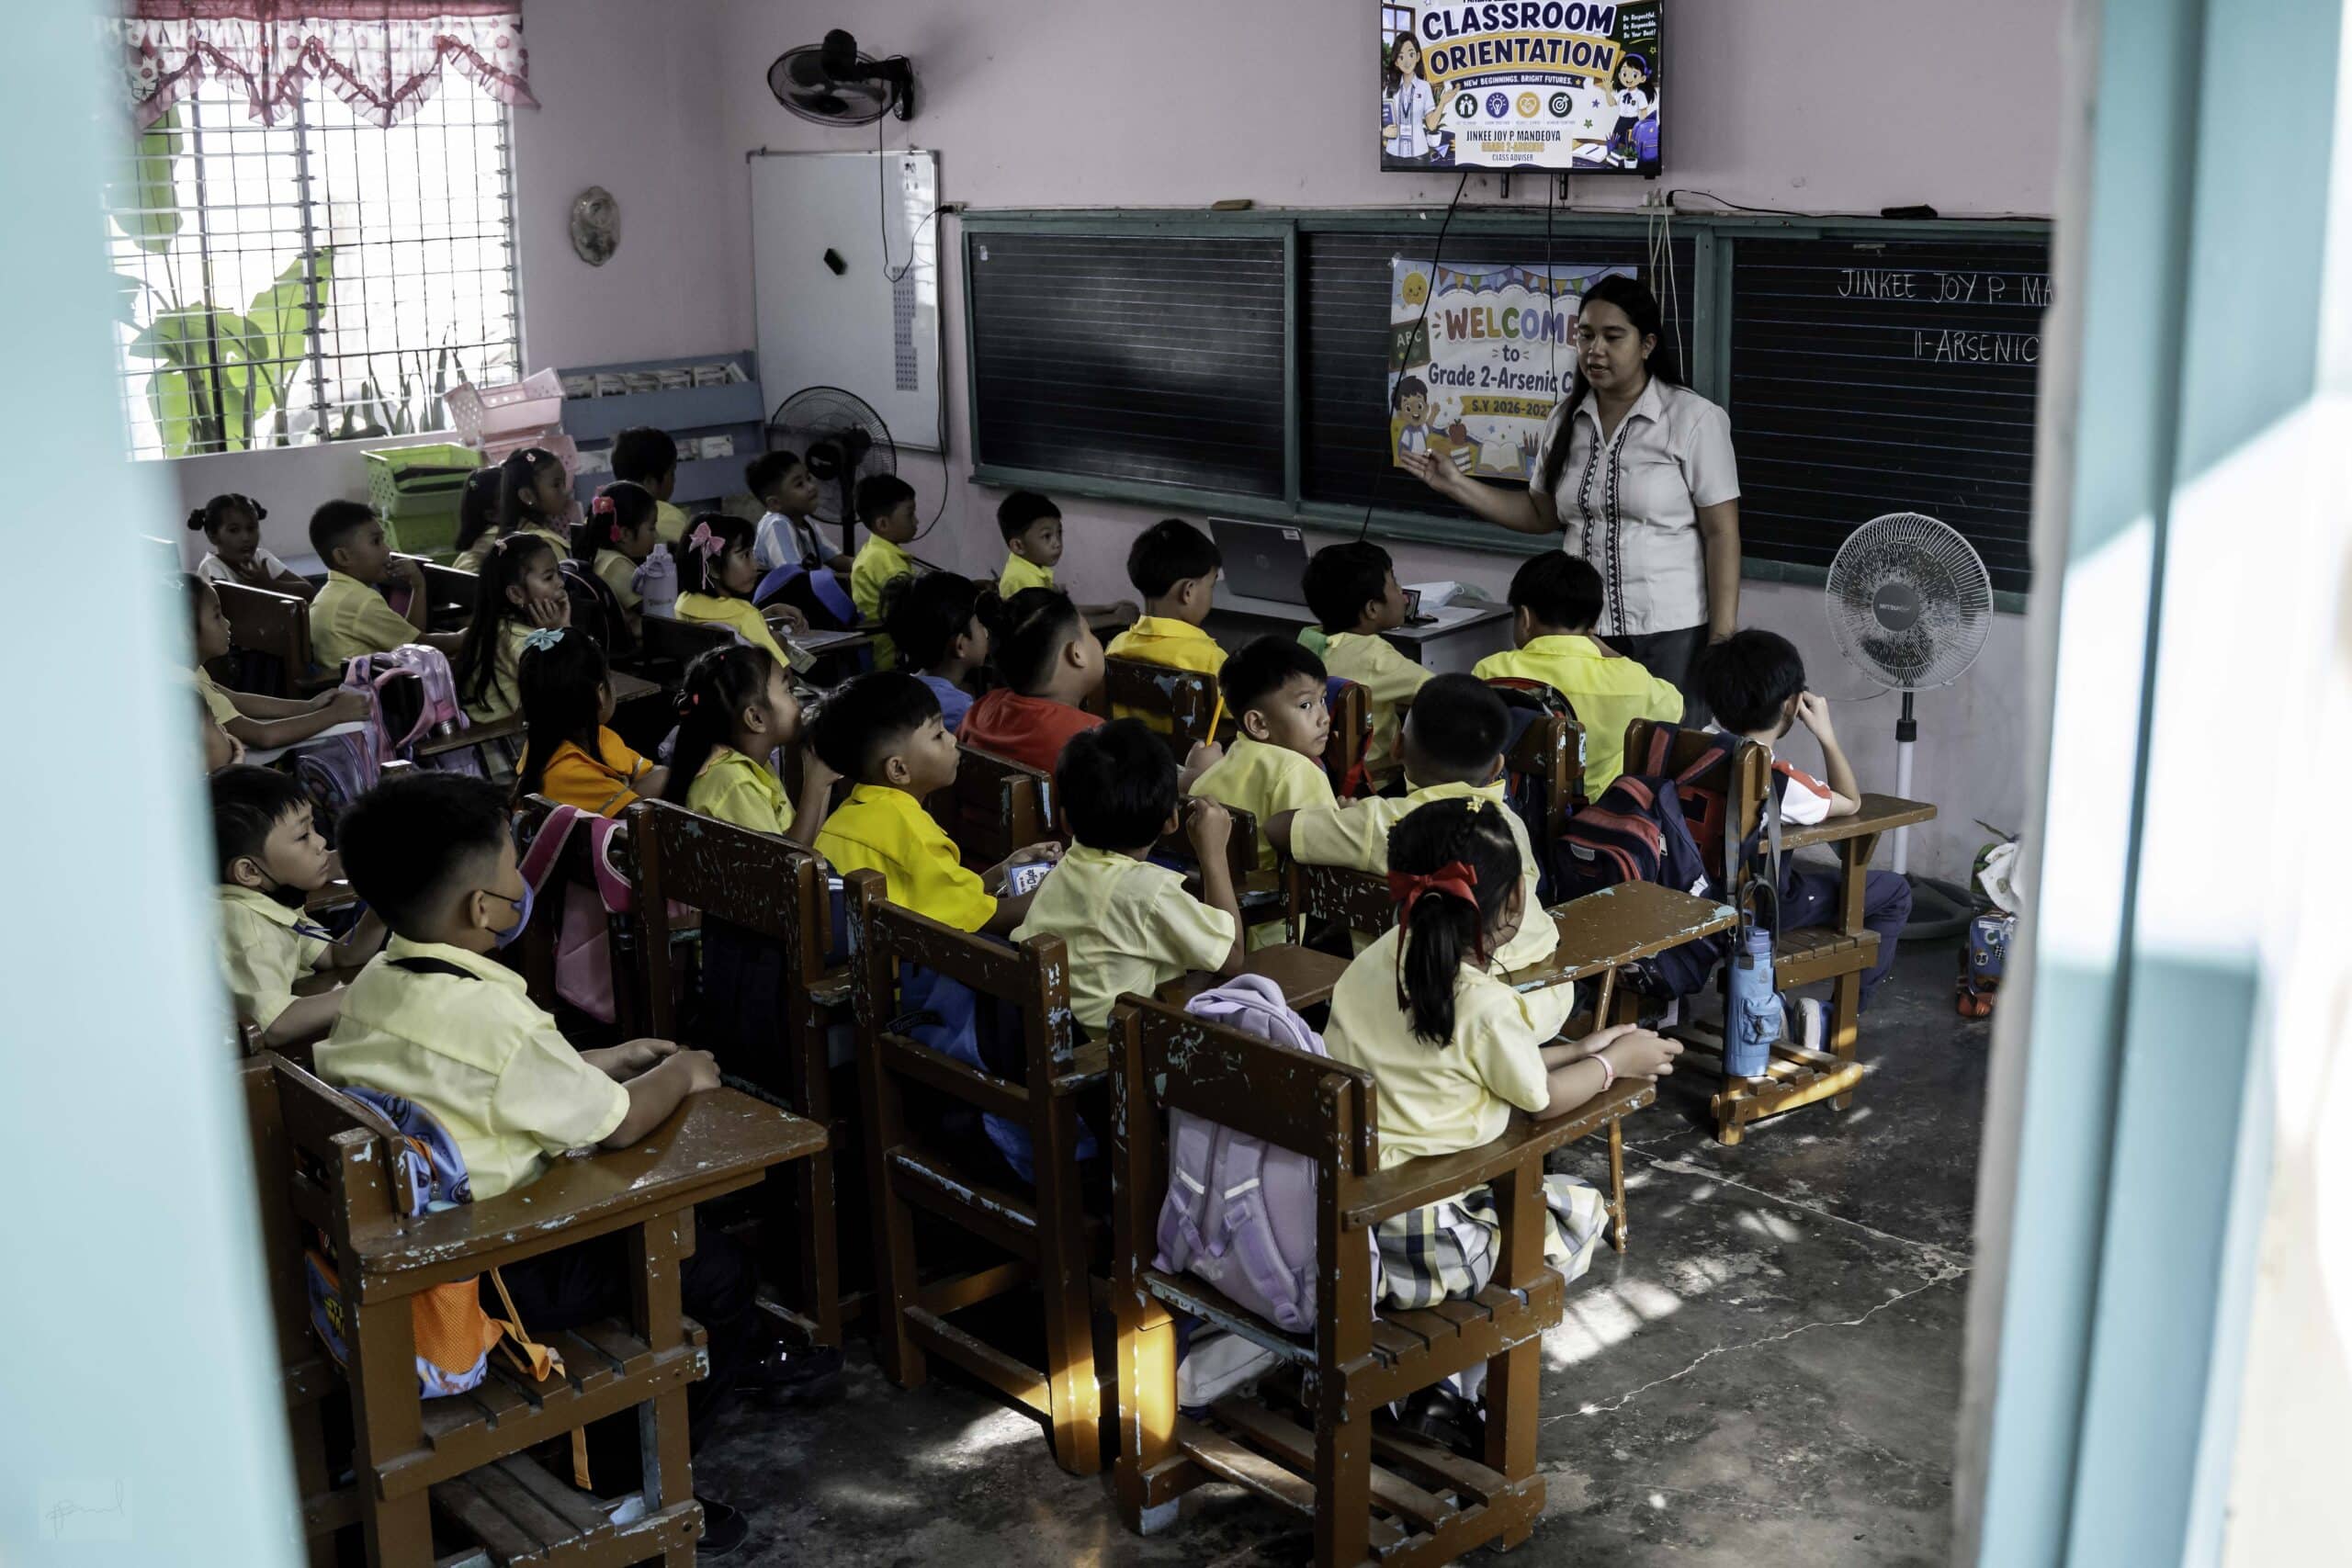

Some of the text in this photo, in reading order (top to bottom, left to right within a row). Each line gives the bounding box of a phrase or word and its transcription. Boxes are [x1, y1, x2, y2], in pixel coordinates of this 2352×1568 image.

[1422, 2, 1615, 39] CLASSROOM
[1430, 38, 1614, 75] ORIENTATION
[1480, 75, 1519, 85] BEGINNINGS.
[1544, 75, 1572, 85] FUTURES.
[1466, 130, 1491, 141] JINKEE
[1493, 130, 1507, 141] JOY
[1492, 153, 1533, 162] CLASS ADVISER
[1838, 269, 1917, 299] JINKEE
[1930, 273, 1977, 303] JOY
[1988, 276, 2007, 304] P.
[1503, 344, 1521, 362] to
[1429, 363, 1475, 387] Grade
[1480, 366, 1558, 393] 2-Arsenic
[1975, 954, 1987, 964] 95
